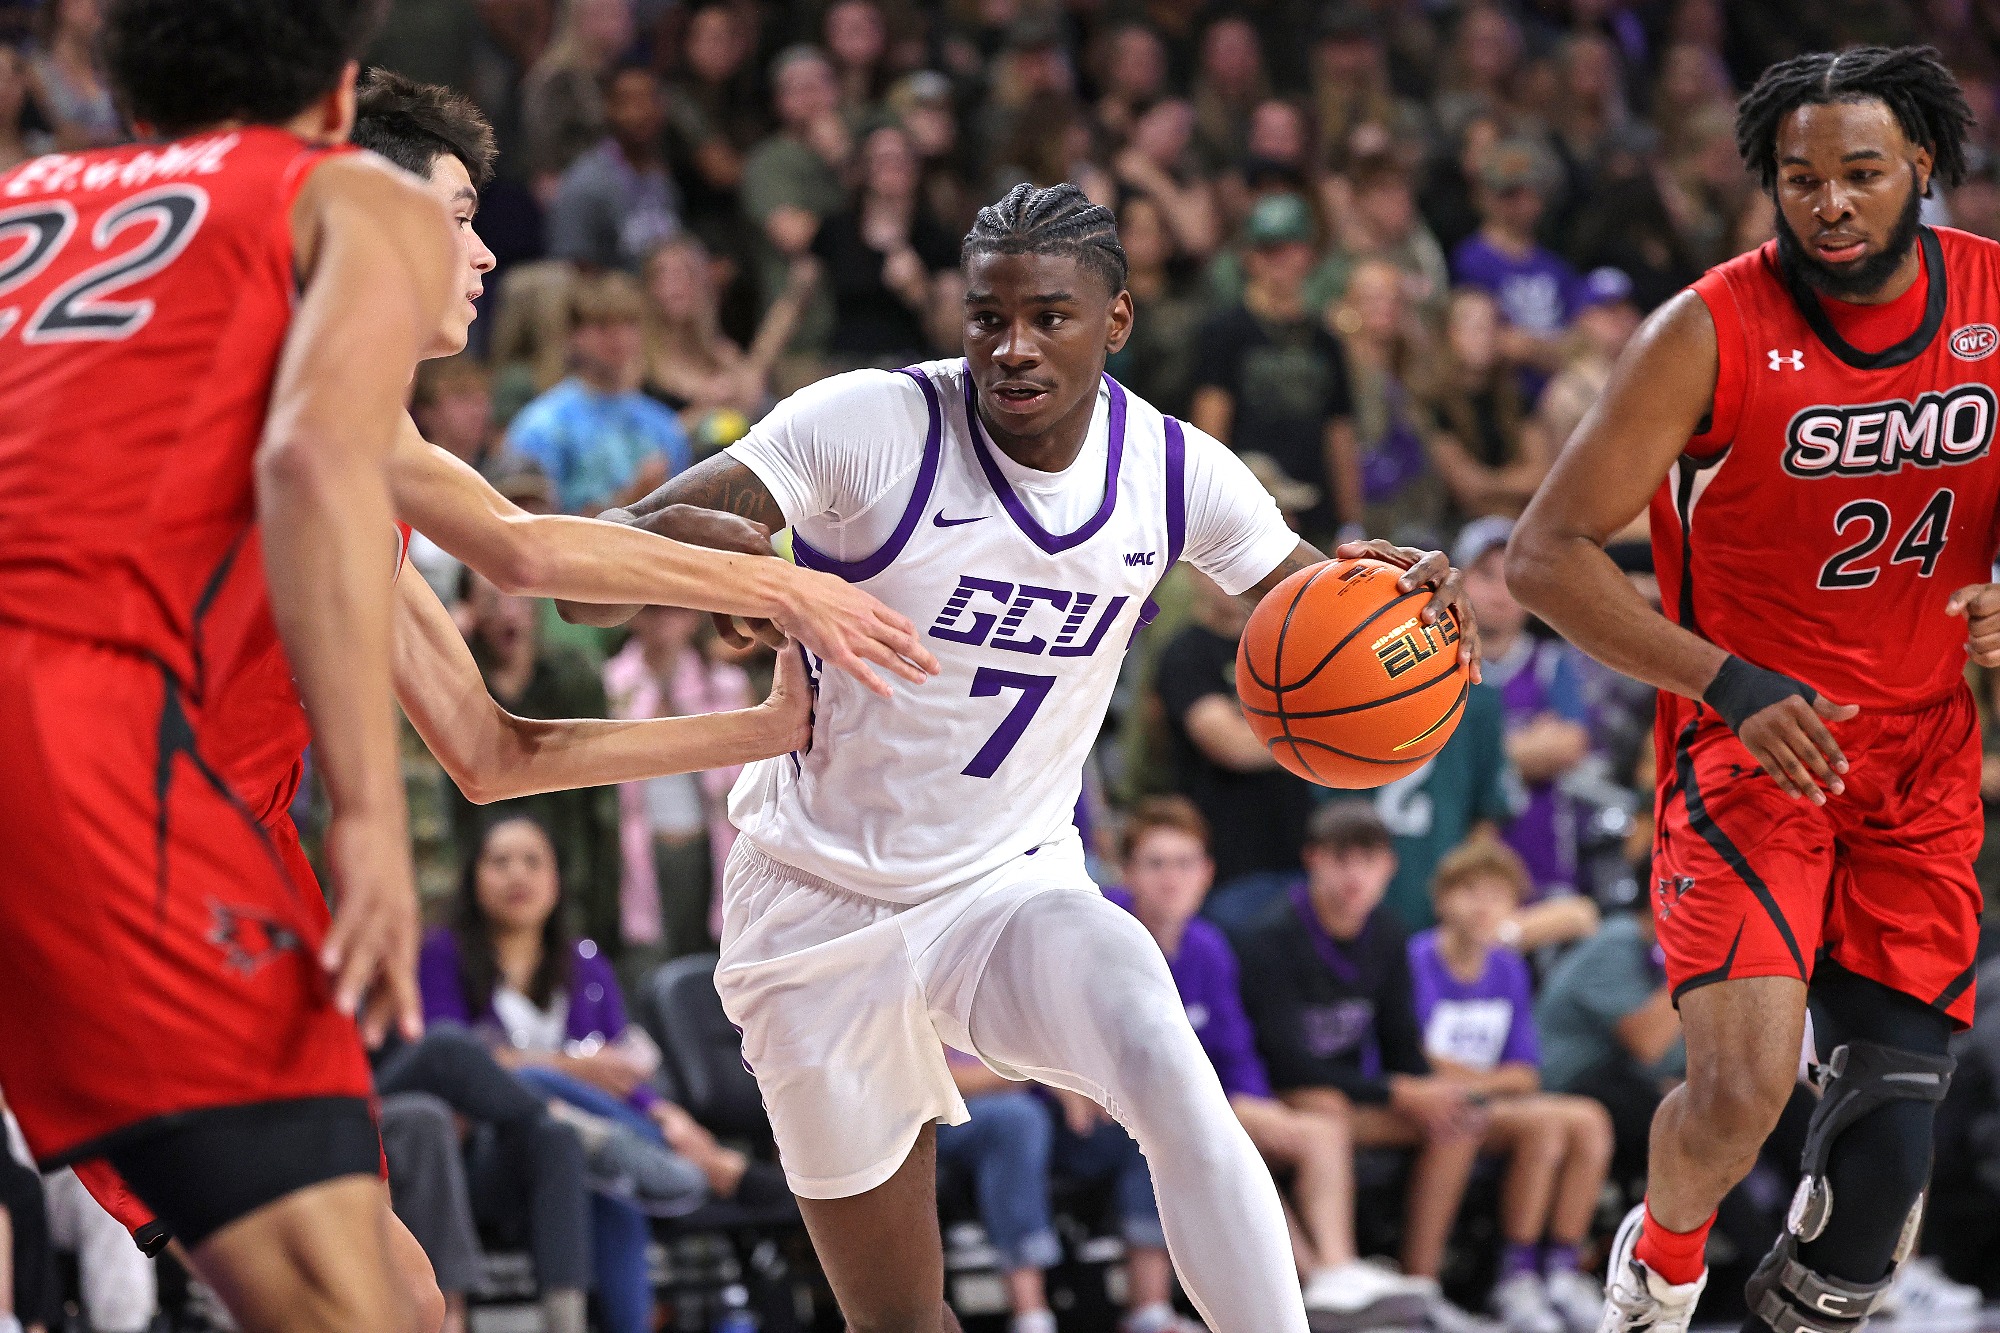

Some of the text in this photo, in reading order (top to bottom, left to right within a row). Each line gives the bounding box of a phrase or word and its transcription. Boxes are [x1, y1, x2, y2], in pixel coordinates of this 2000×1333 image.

[1958, 333, 1989, 351] OVC
[1786, 387, 1994, 476] SEMO
[1123, 551, 1156, 566] WAC
[1817, 488, 1955, 589] 24
[929, 575, 1129, 657] GCU
[960, 667, 1057, 779] 7
